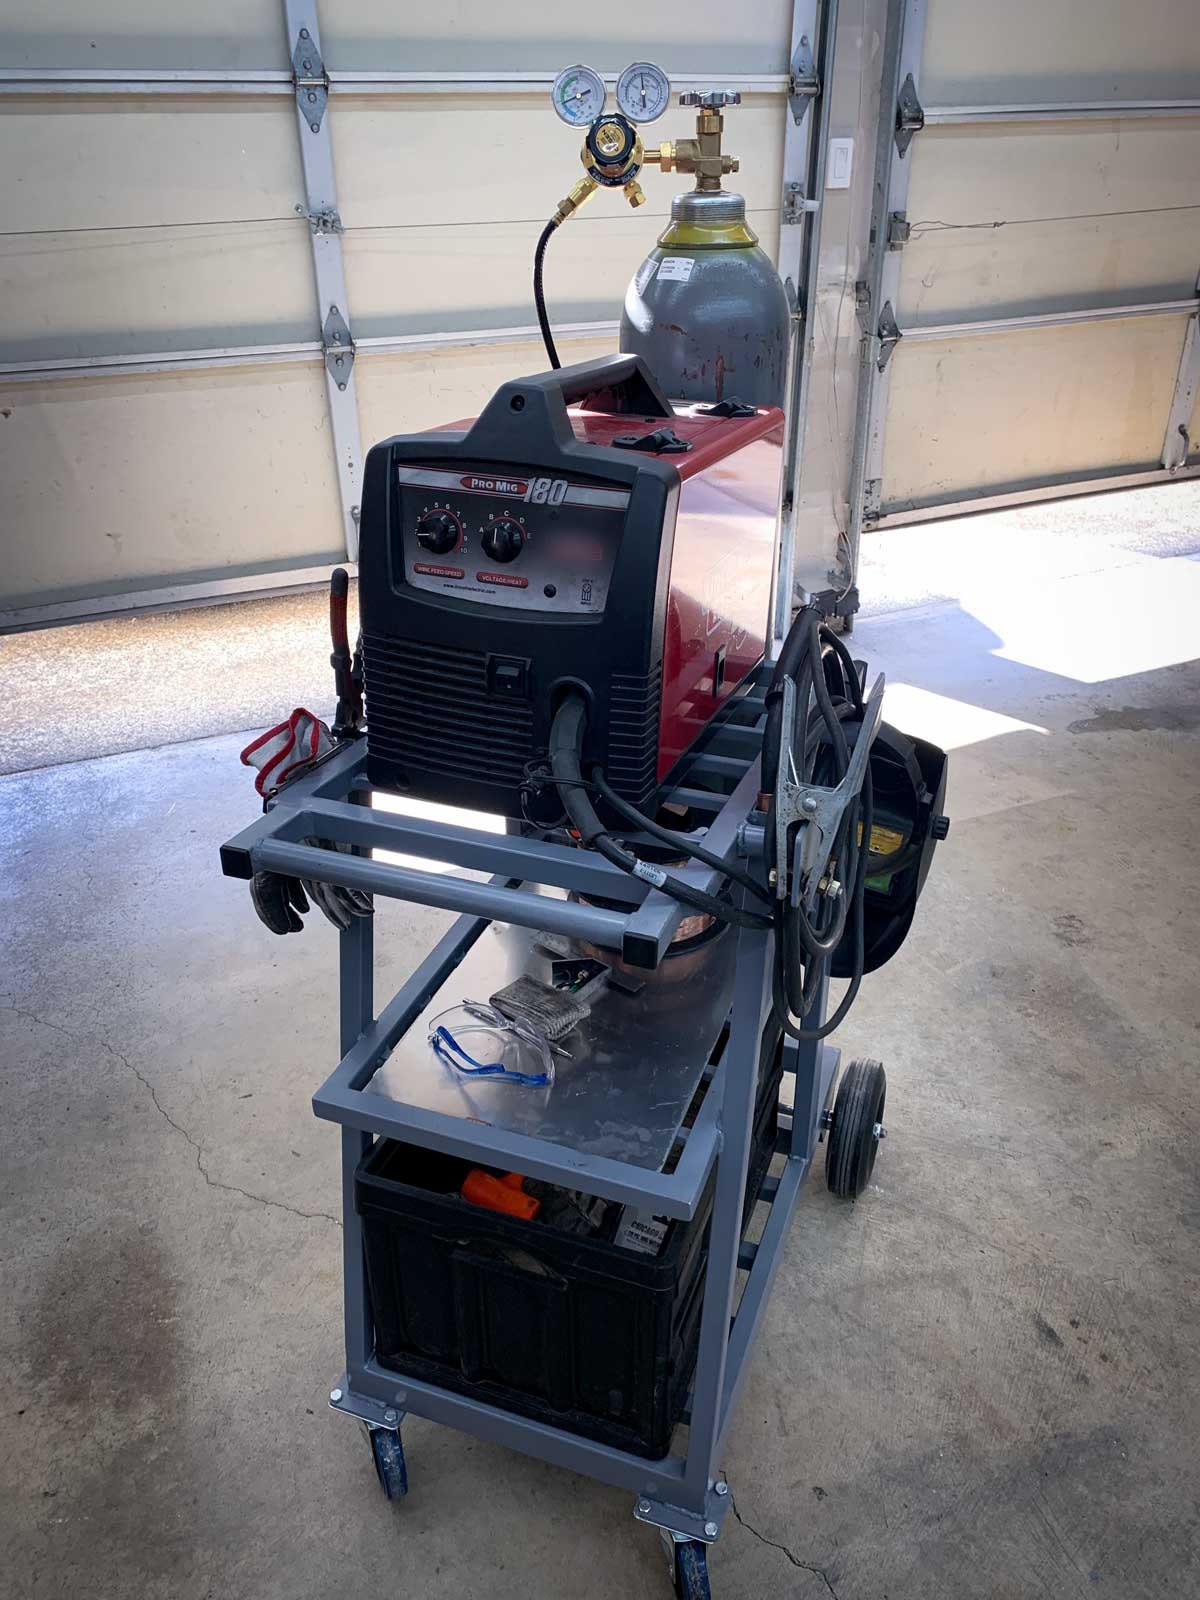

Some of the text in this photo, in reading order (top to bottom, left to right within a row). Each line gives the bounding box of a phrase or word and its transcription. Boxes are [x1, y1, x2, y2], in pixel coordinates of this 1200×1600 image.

[471, 477, 568, 506] PRO MIG 180
